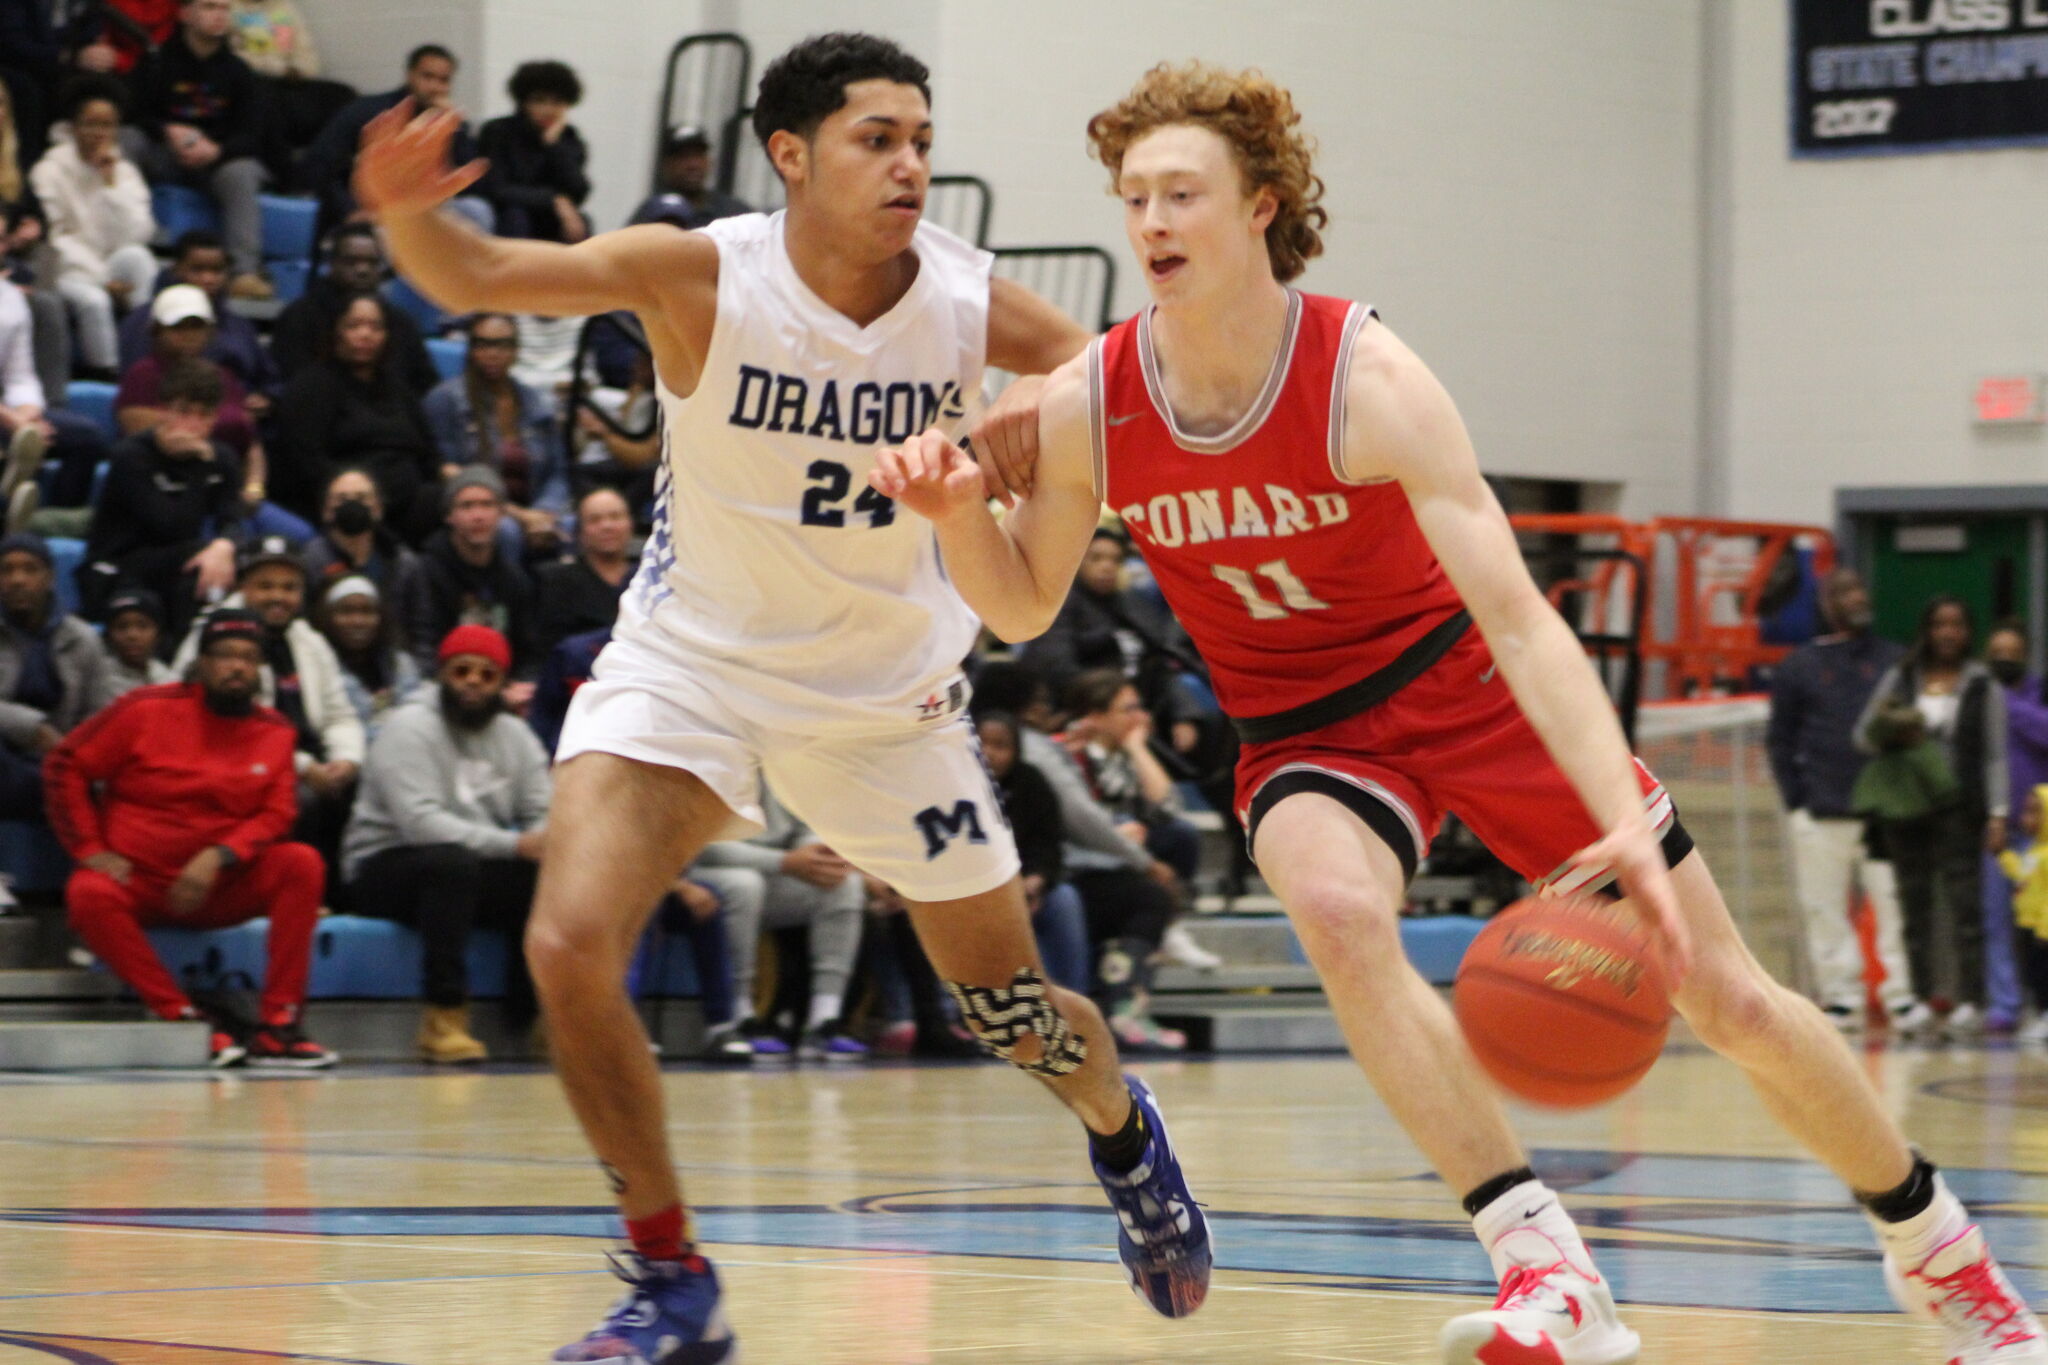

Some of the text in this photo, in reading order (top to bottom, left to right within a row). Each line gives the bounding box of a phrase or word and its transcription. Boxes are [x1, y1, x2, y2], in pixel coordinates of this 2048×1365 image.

[1870, 0, 2010, 38] CLASS
[1808, 44, 1919, 92] STATE
[801, 458, 896, 528] 24
[1210, 558, 1332, 620] 11
[914, 799, 989, 861] M
